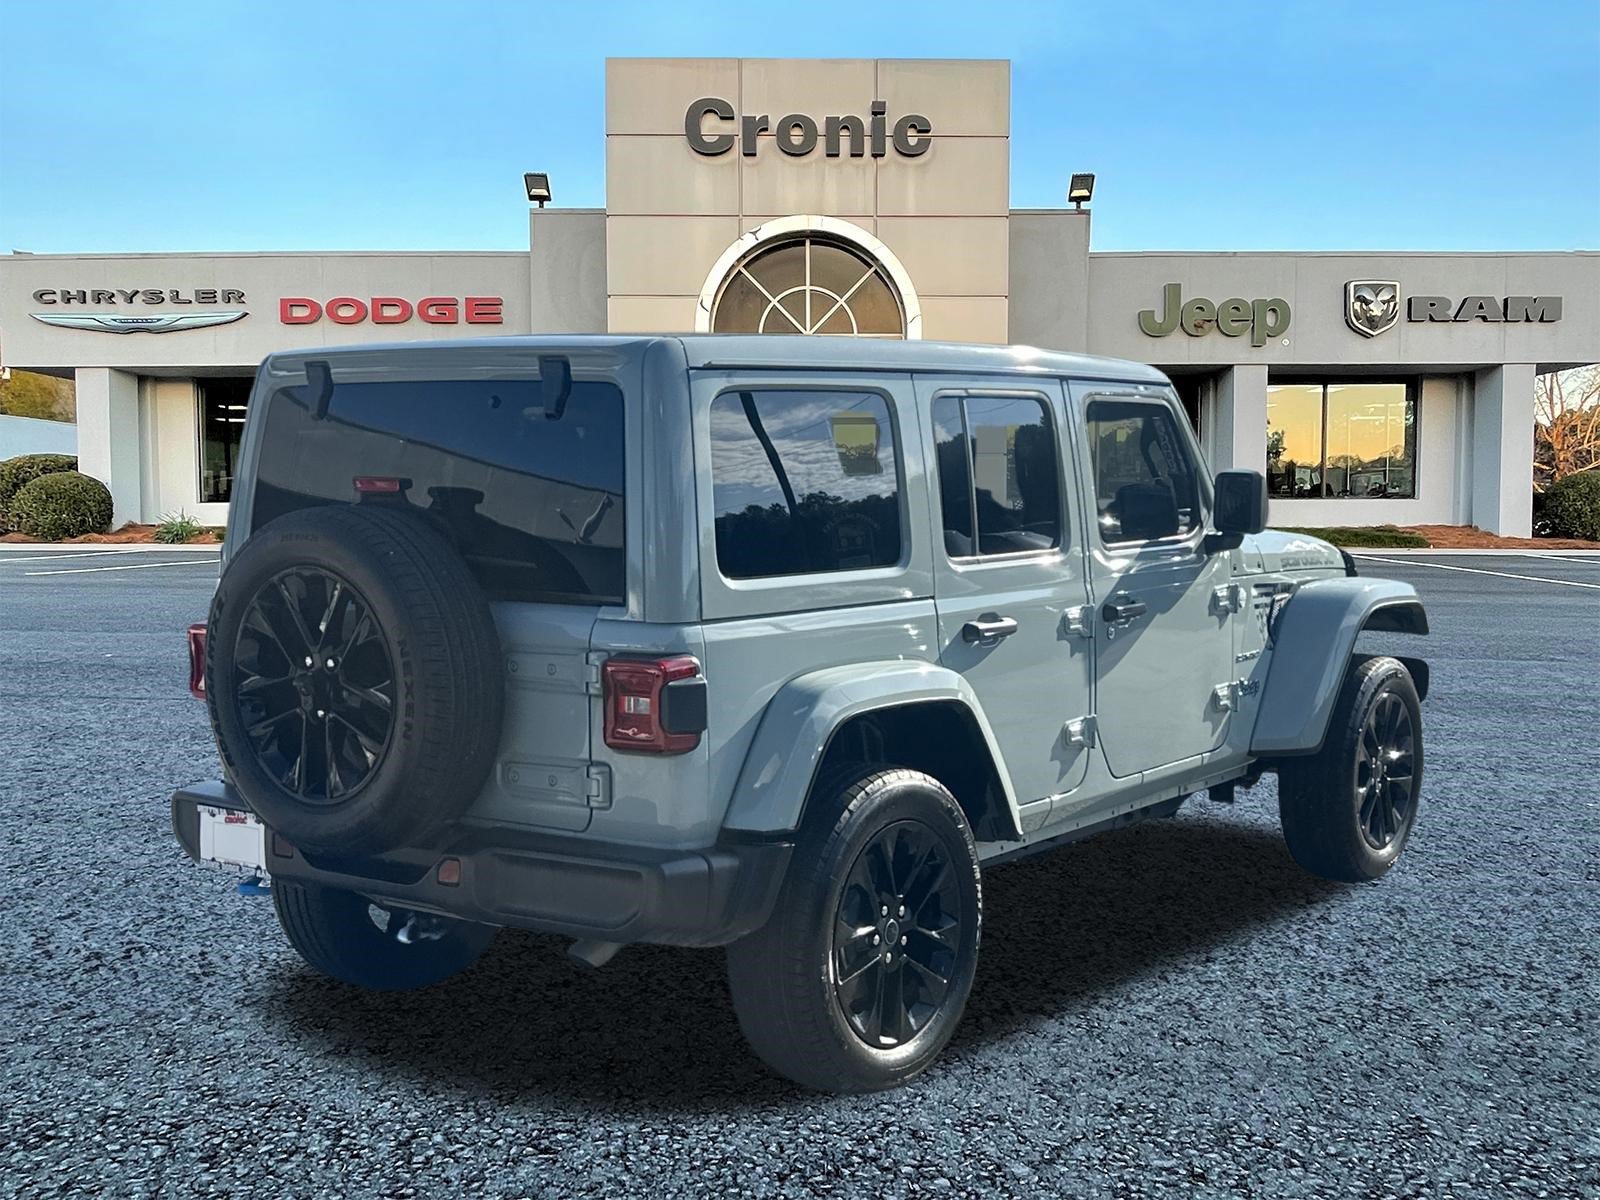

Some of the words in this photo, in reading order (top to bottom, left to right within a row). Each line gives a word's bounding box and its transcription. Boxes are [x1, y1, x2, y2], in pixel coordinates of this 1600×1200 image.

[685, 97, 932, 158] Cronic
[32, 289, 247, 305] CHRYSLER
[279, 296, 504, 325] DODGE
[1138, 283, 1291, 347] Jeep
[1407, 295, 1563, 323] RAM
[398, 638, 415, 741] NEXEN
